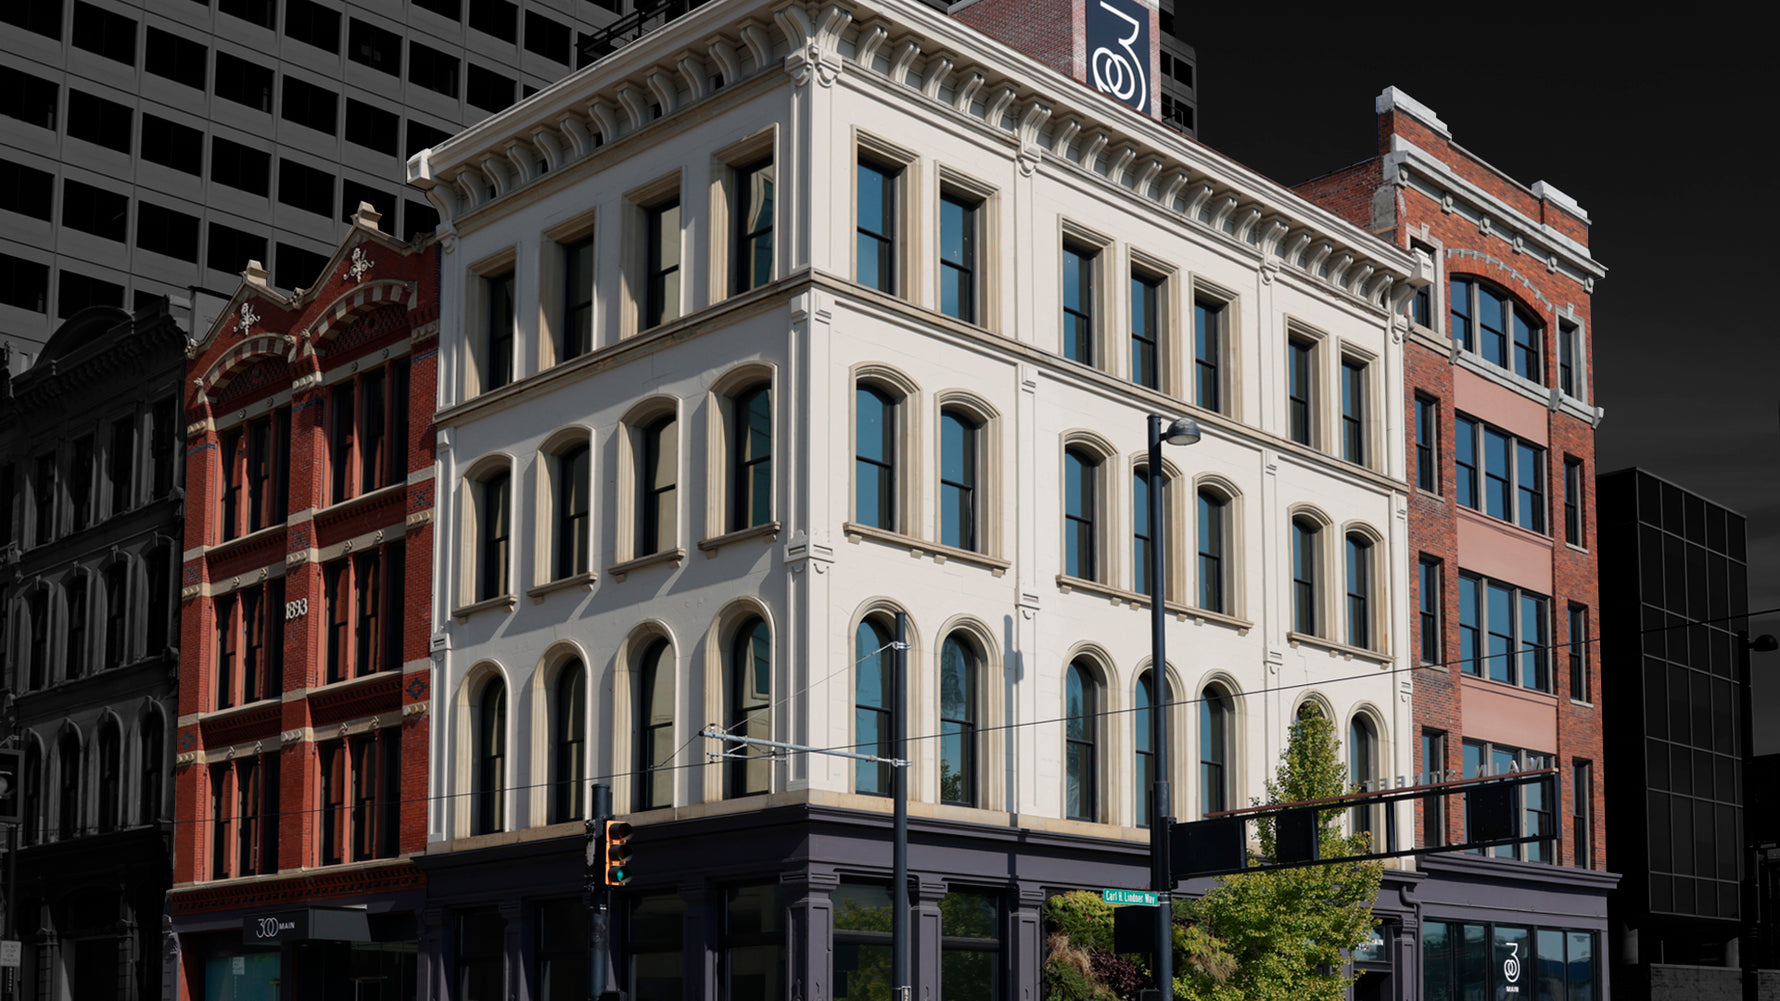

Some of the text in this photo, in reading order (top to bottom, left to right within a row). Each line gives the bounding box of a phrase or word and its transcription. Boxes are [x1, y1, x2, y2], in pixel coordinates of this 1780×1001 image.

[286, 598, 308, 620] 1893
[1105, 890, 1117, 901] Carl
[1124, 892, 1143, 903] Lindner
[1145, 893, 1155, 905] Way
[256, 917, 279, 938] 300
